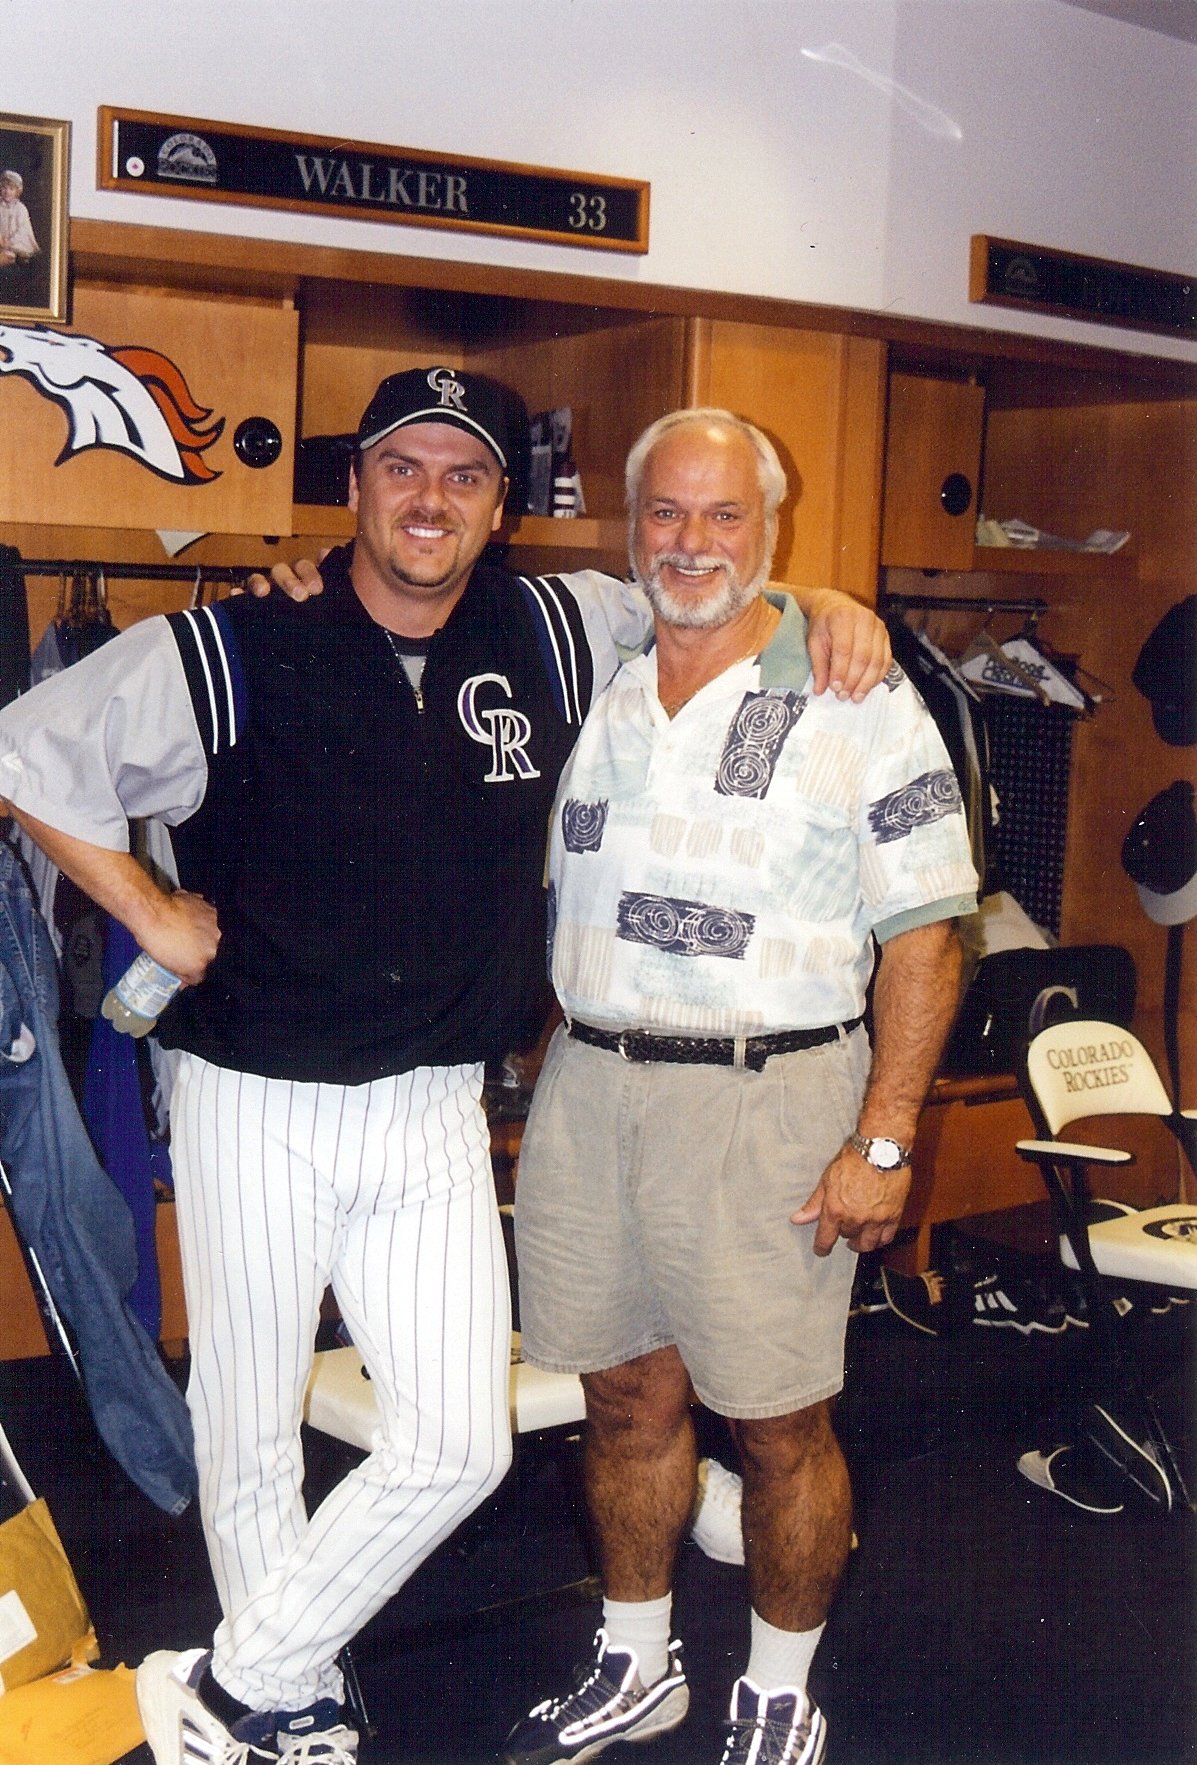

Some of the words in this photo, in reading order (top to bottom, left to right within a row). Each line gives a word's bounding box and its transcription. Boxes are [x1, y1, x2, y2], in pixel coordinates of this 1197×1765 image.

[295, 154, 468, 213] WALKER
[569, 193, 606, 231] 33
[1046, 1040, 1134, 1070] COLORADO
[1063, 1065, 1129, 1093] ROCKIES
